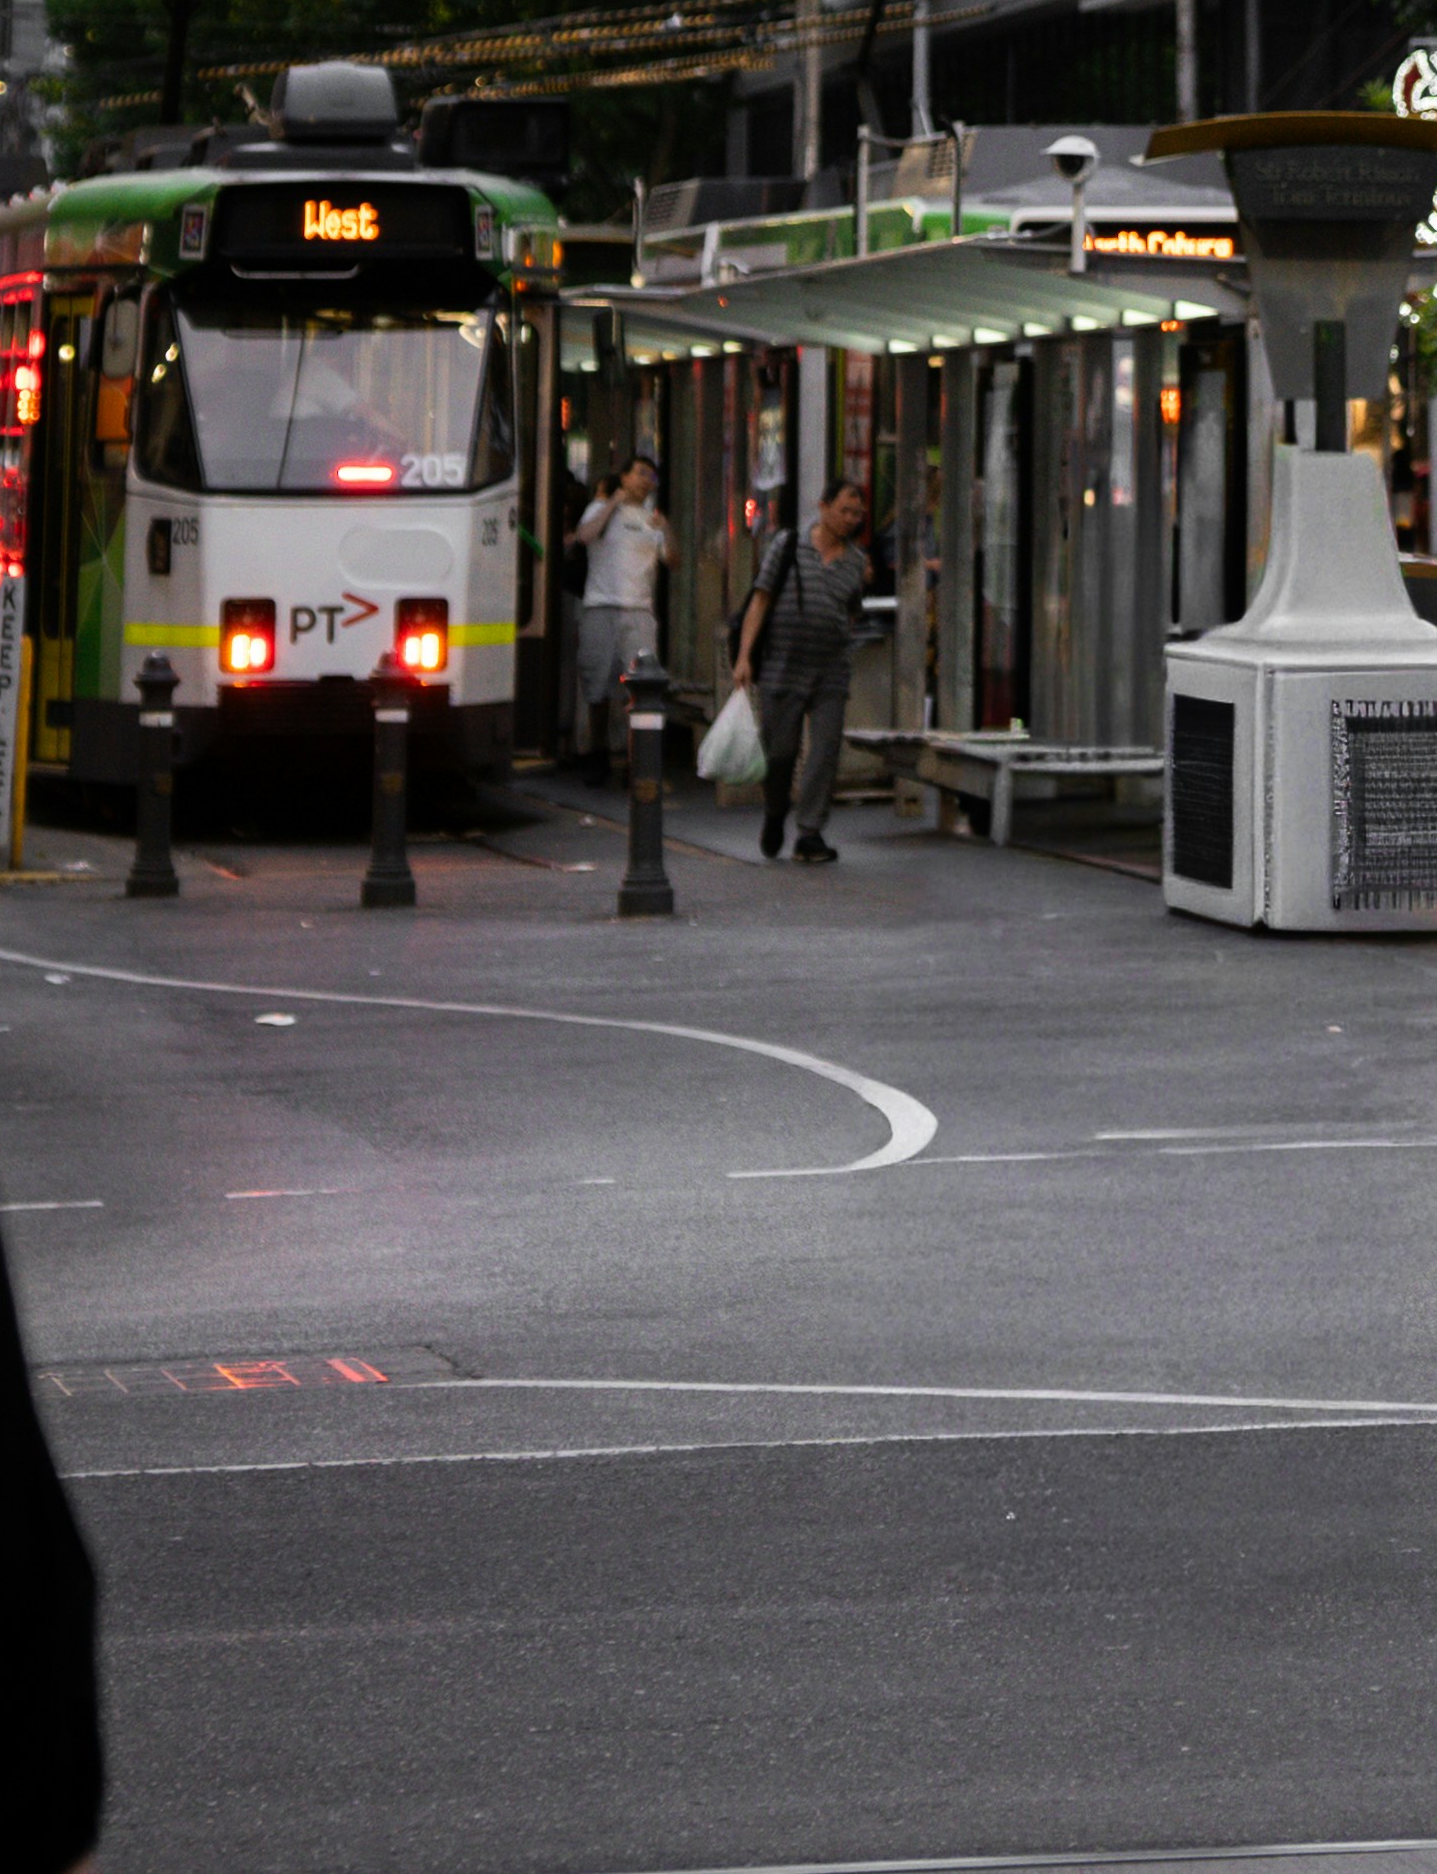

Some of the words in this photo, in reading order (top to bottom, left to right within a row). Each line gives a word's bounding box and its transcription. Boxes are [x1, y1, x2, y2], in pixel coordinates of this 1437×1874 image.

[304, 199, 380, 241] West
[400, 452, 464, 488] 205
[171, 517, 200, 547] 205
[288, 606, 344, 645] PT
